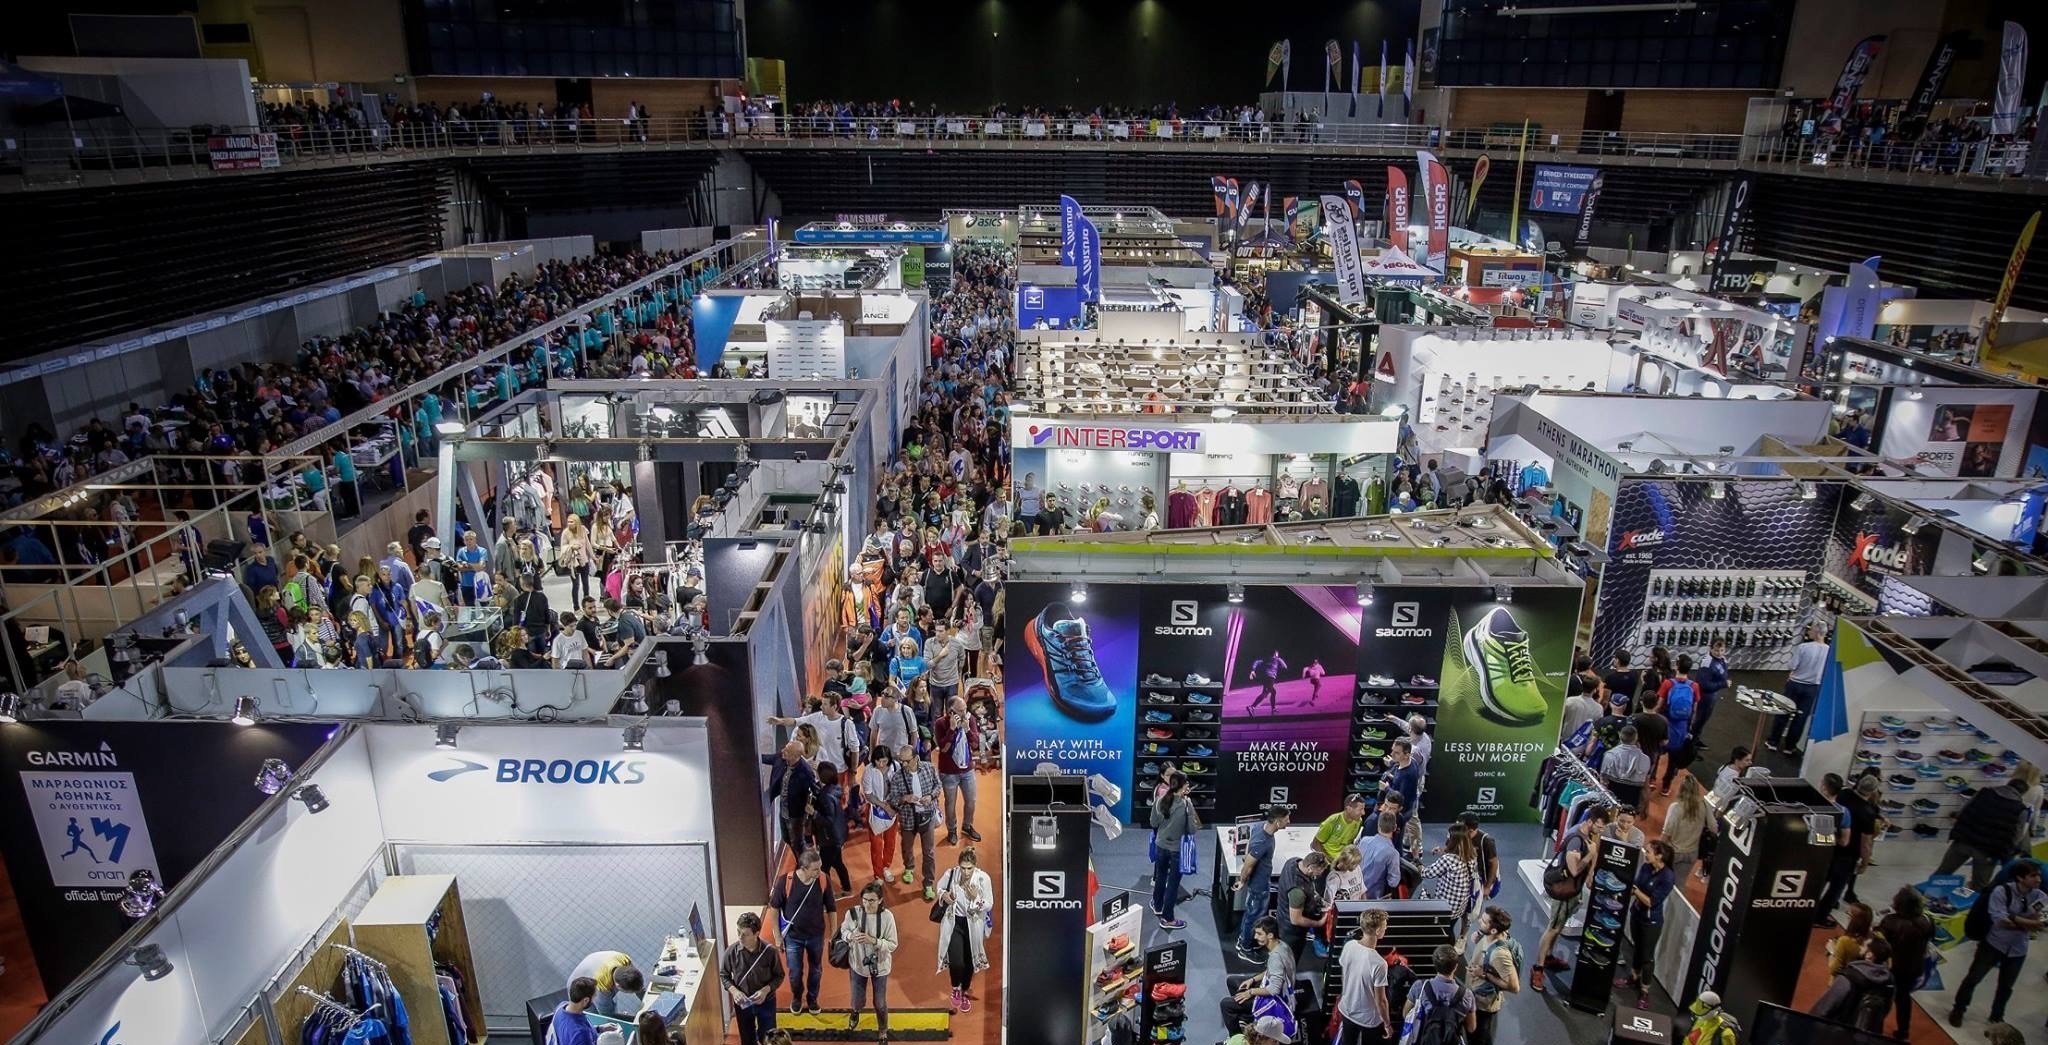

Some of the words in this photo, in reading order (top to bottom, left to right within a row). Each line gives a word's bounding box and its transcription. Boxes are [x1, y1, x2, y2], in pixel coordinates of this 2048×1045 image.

[838, 213, 887, 223] SAMSUNG
[978, 217, 1003, 227] asics
[904, 263, 921, 272] RUN
[1498, 272, 1526, 282] fitway
[1722, 274, 1752, 293] TRX
[1056, 428, 1200, 450] INTERSPORT
[1537, 419, 1567, 447] ATHENS
[1569, 439, 1619, 482] MARATHON
[1035, 739, 1069, 750] PLAY
[1072, 739, 1103, 750] WITH
[1249, 741, 1286, 751] MAKE
[1290, 741, 1318, 751] ANY
[1444, 742, 1472, 752] LESS
[1475, 742, 1544, 752] VIBRATION
[27, 751, 118, 767] GARMIN
[1015, 750, 1054, 760] MORE
[1057, 750, 1122, 760] COMFORT
[1236, 751, 1290, 762] TERRAIN
[1294, 751, 1329, 762] YOUR
[1458, 753, 1485, 763] RUN
[1488, 753, 1527, 763] MORE
[496, 759, 647, 784] BROOKS
[1237, 762, 1326, 772] PLAYGROUND
[32, 778, 128, 790] ΜΑΡΑΘΩΝΙΟΣ
[54, 791, 113, 802] ΑΘΗΝΑΣ
[59, 803, 123, 811] ΑΥΘΕΝΤΙΚΟΣ
[65, 890, 99, 902] official
[100, 890, 126, 902] time
